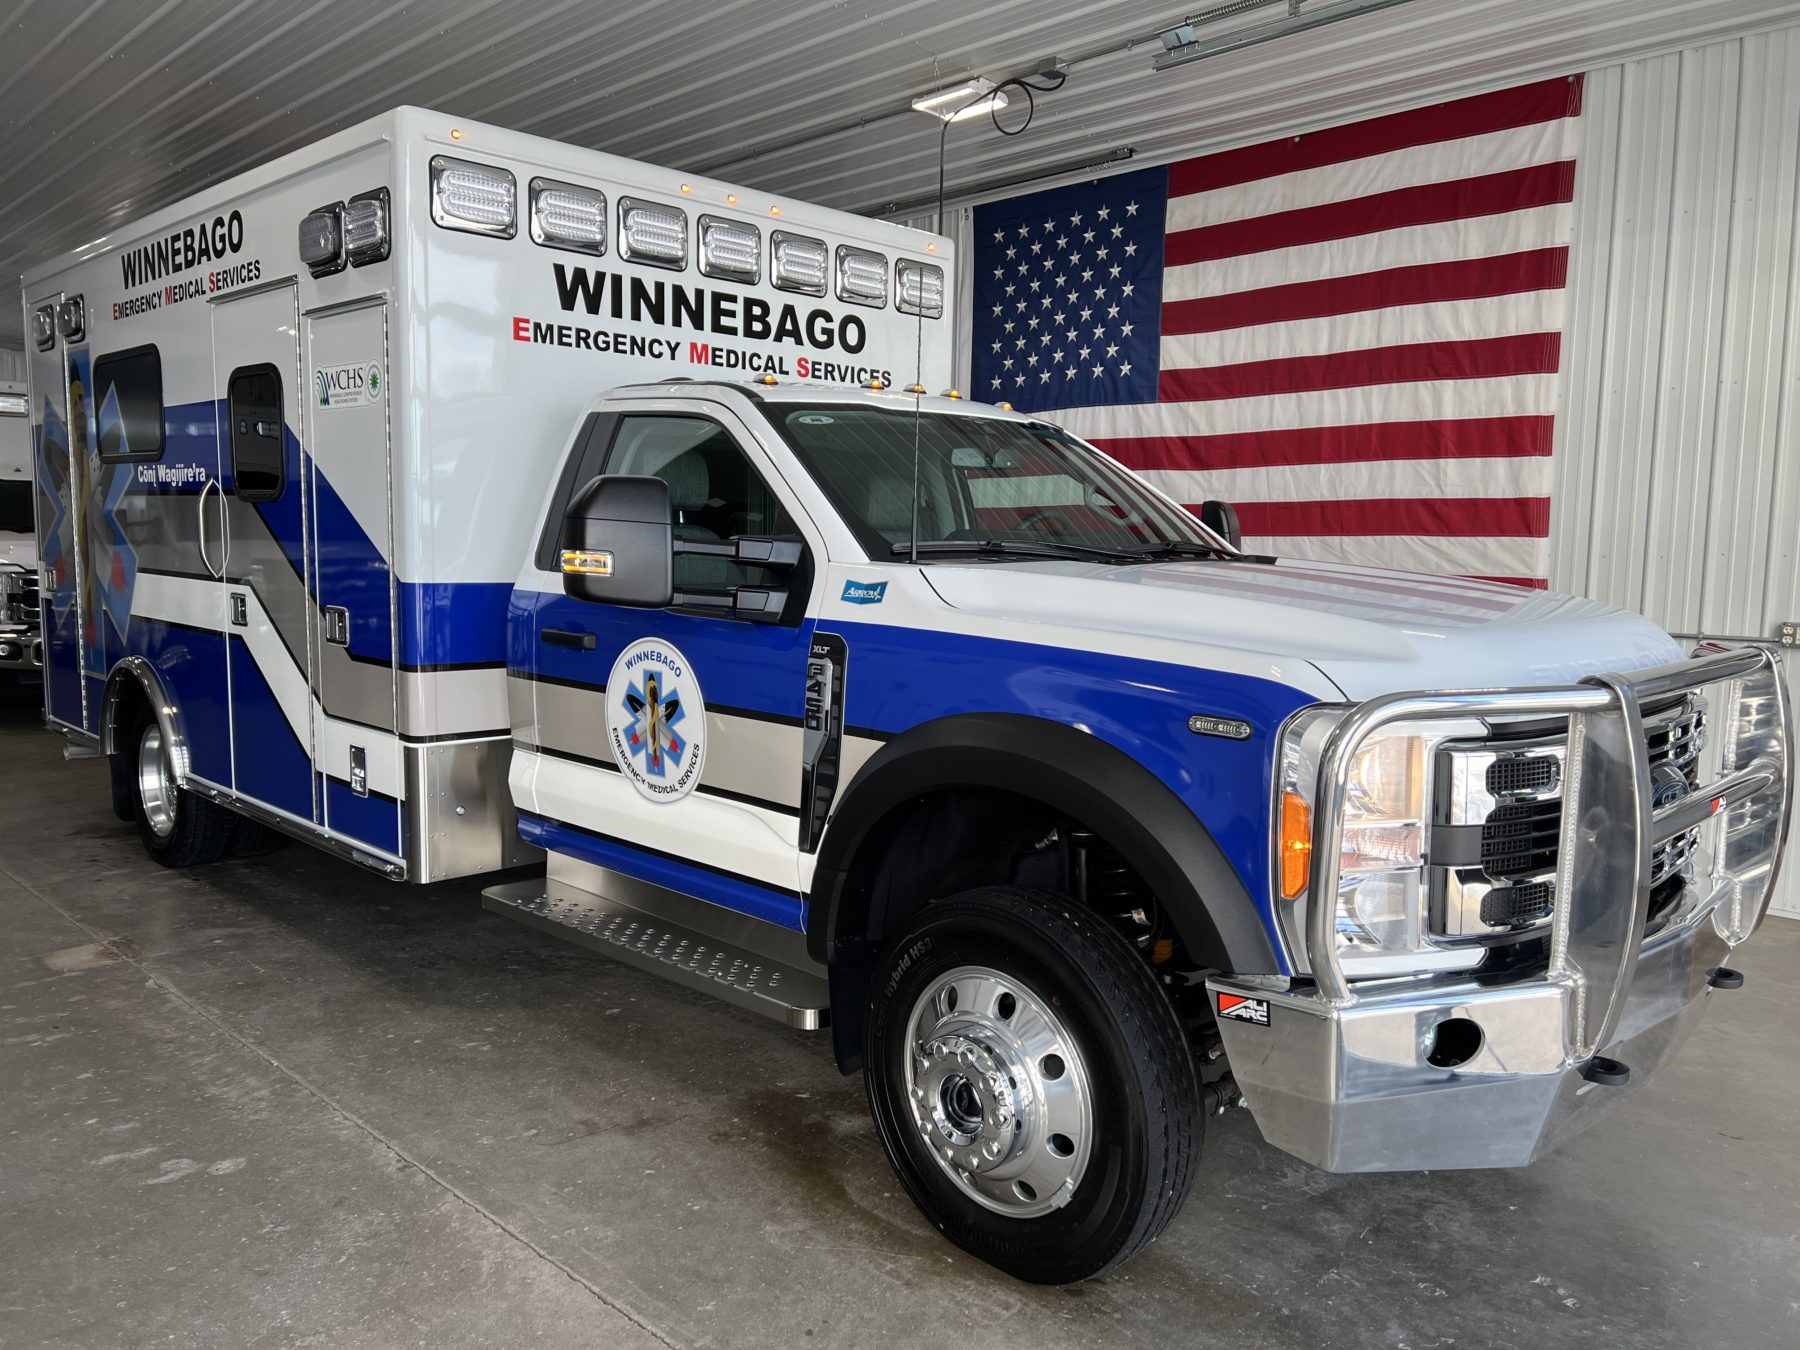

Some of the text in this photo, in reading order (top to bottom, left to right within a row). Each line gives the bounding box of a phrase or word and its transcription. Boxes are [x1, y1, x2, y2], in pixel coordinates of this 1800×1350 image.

[121, 210, 243, 290] WINNEBAGO
[113, 259, 261, 320] EMERGENCY MEDICAL SERVICES
[552, 263, 867, 354] WINNEBAGO
[325, 367, 364, 391] WCHS
[512, 317, 892, 388] EMERGENCY MEDICAL SERVICES
[624, 650, 682, 678] WINNEBAGO
[812, 644, 830, 654] XLT
[612, 727, 700, 794] EMERGENCY MEDICAL SERVICES
[884, 954, 911, 996] Hybrid
[909, 936, 932, 960] HS3
[1228, 999, 1267, 1012] ALI
[1230, 1008, 1268, 1021] ARC
